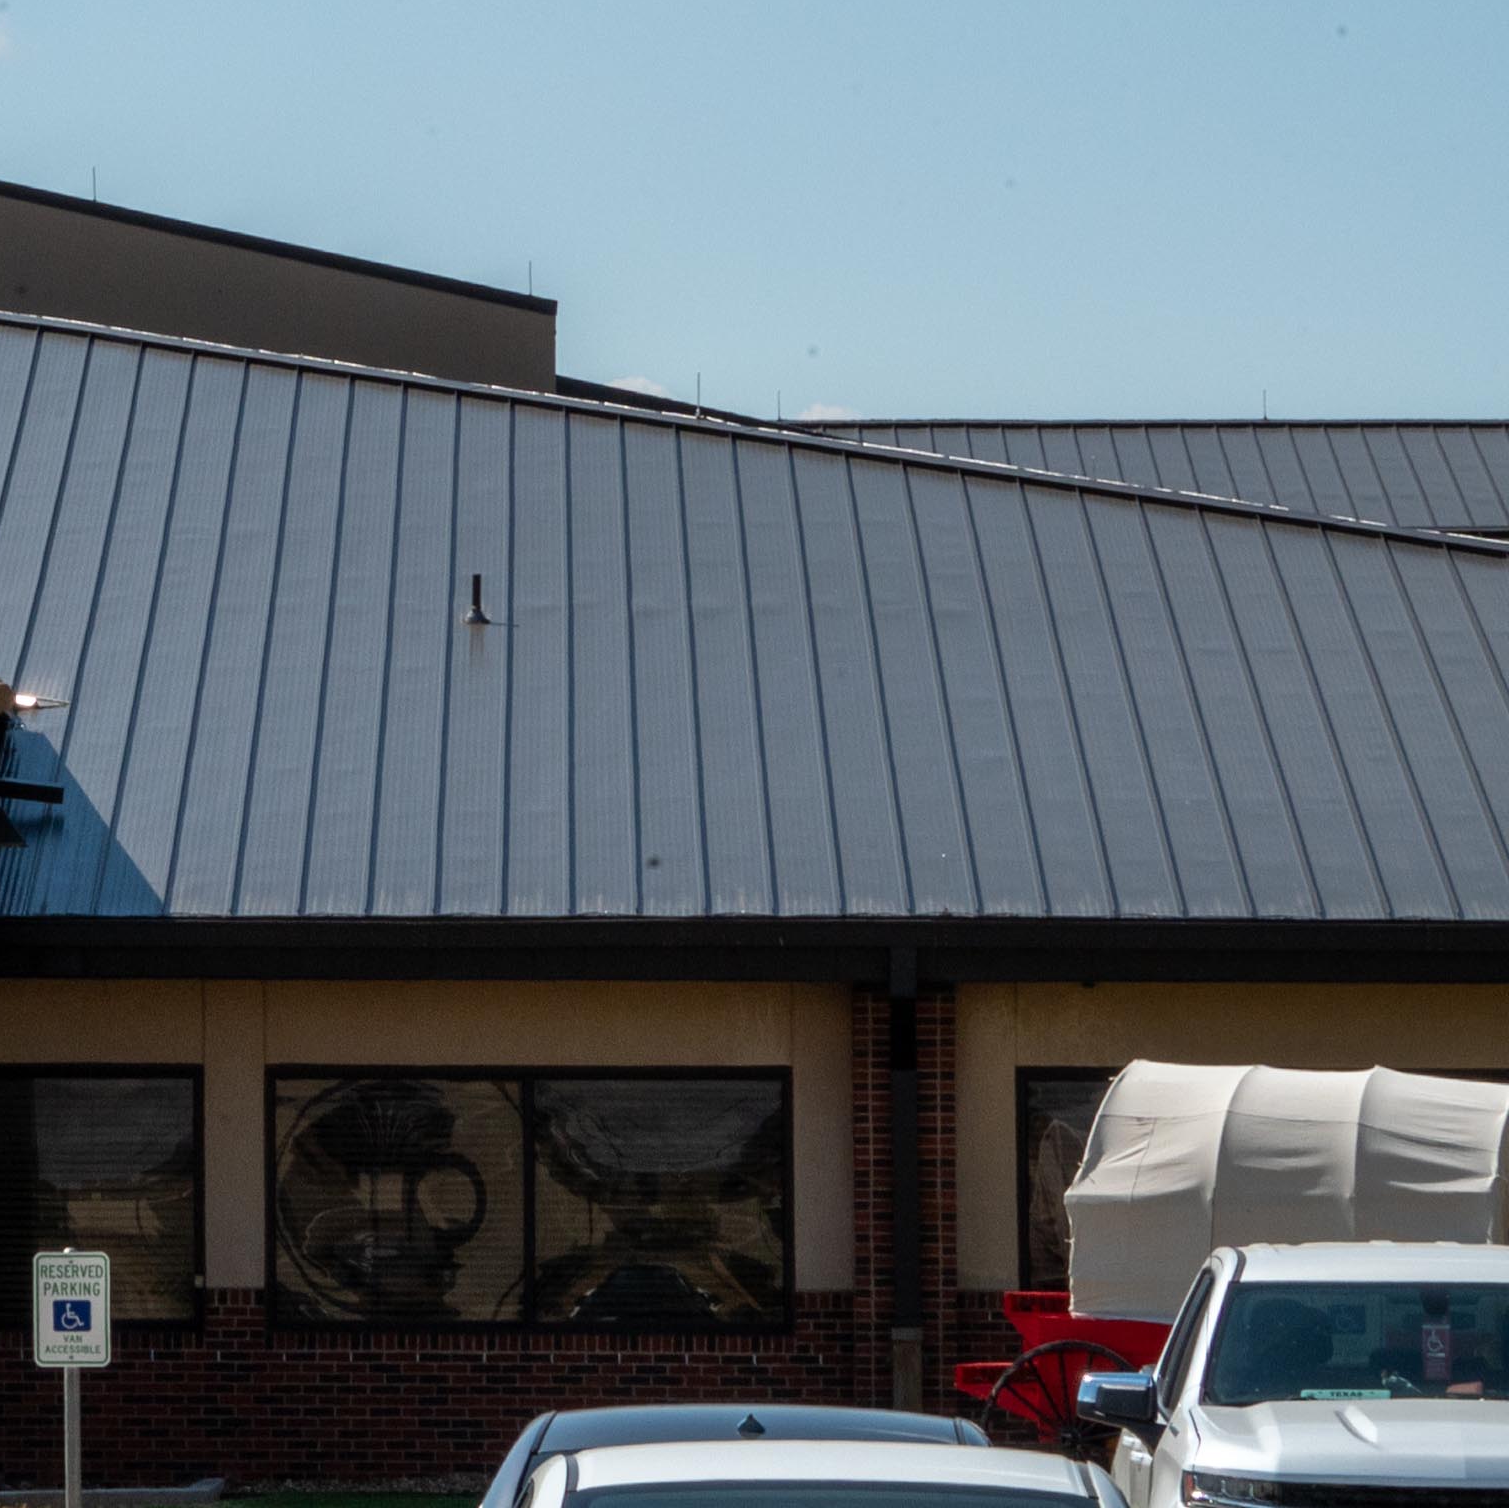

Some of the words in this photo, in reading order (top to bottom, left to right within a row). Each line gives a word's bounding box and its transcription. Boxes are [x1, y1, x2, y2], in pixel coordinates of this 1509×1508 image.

[40, 1264, 104, 1279] RESERVED
[43, 1282, 101, 1297] PARKING
[63, 1334, 83, 1343] VAN
[45, 1345, 102, 1355] ACCESSIBLE
